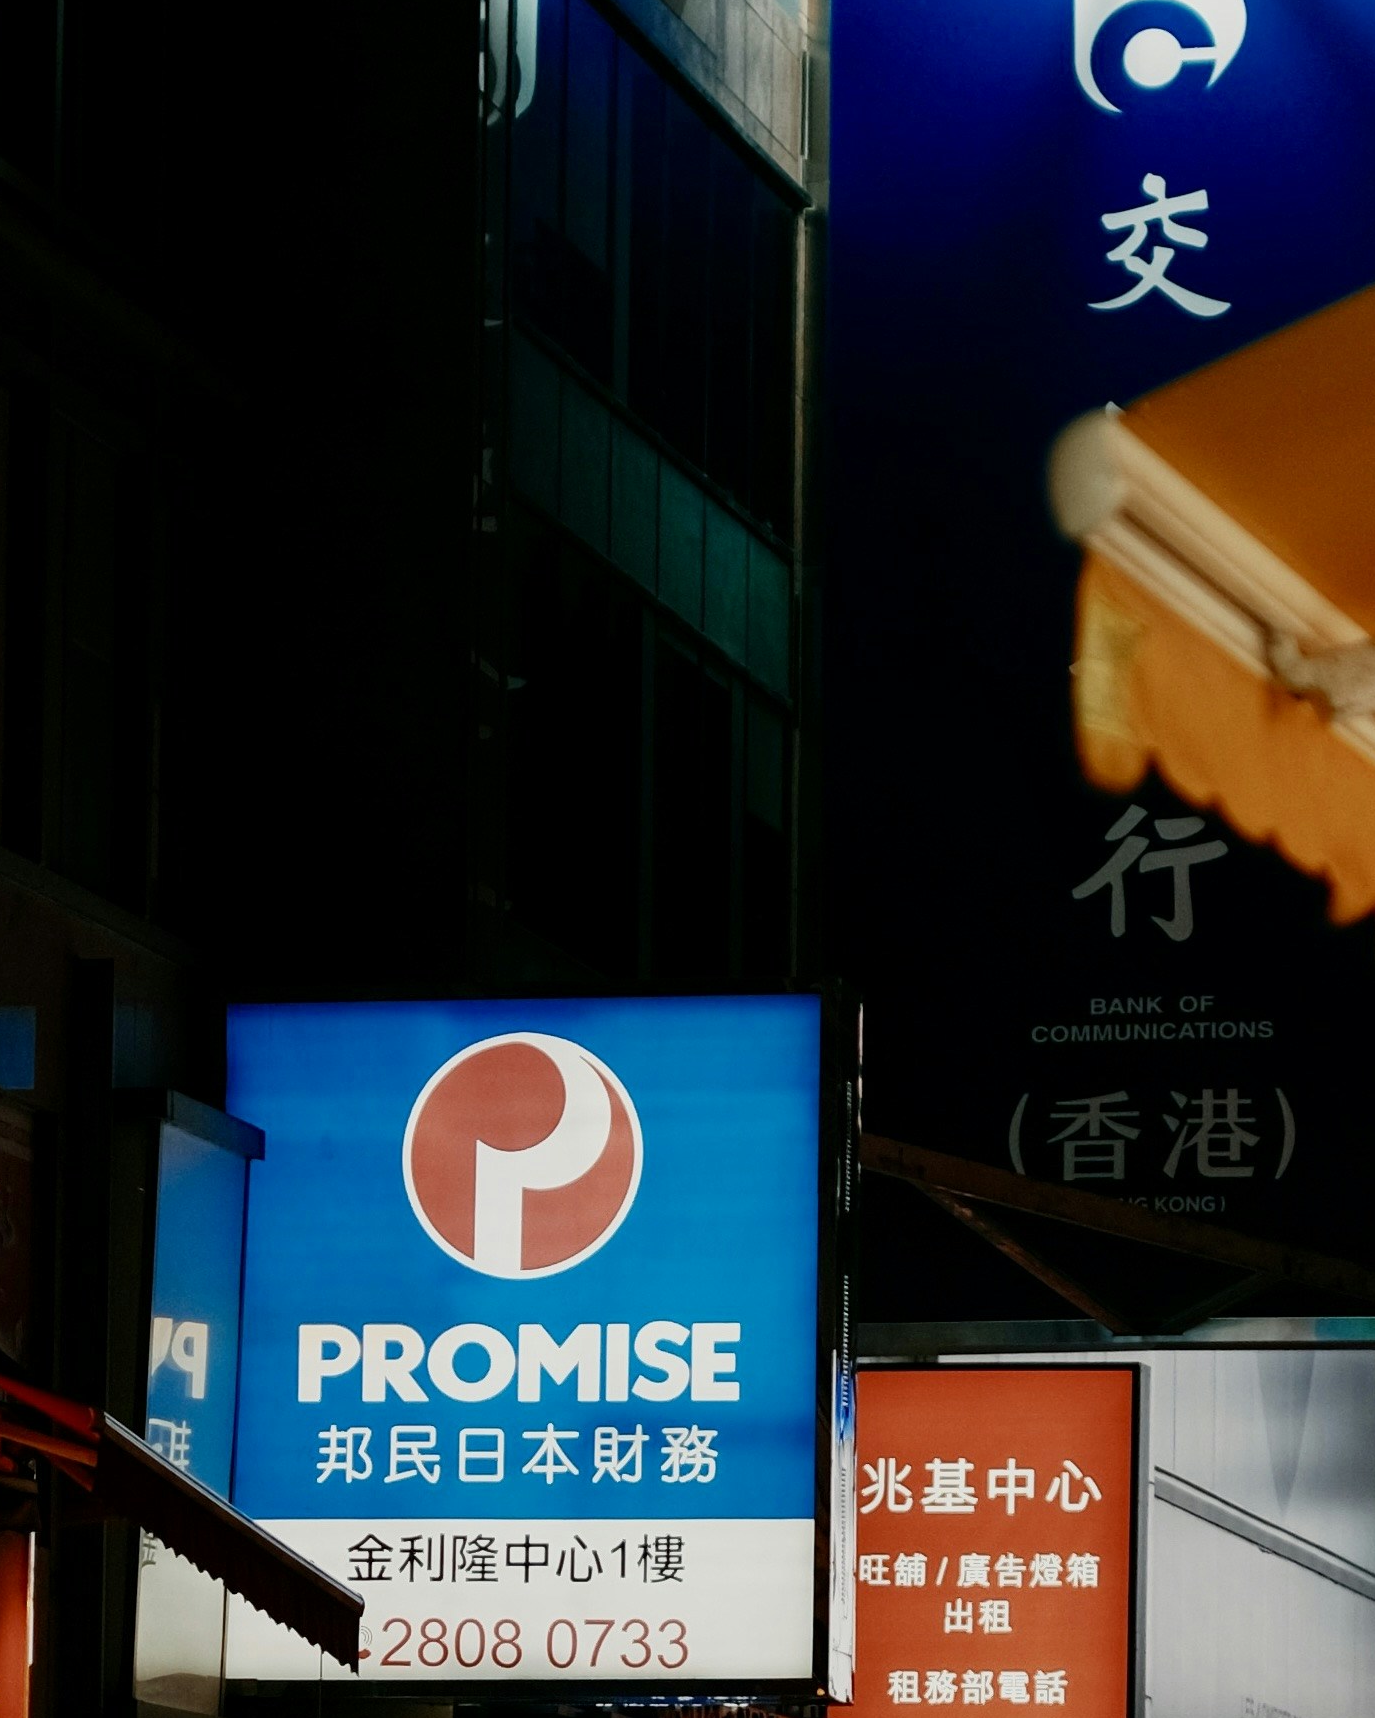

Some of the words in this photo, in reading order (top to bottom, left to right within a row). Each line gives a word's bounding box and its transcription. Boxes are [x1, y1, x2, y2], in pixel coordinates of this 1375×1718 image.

[1089, 995, 1163, 1015] BANK
[1178, 994, 1215, 1014] OF
[1030, 1019, 1275, 1044] COMMUNICATIONS
[1008, 1086, 1296, 1182] (香港)
[297, 1320, 741, 1404] PROMISE
[315, 1424, 720, 1485] 邦民日本財務
[860, 1457, 1103, 1517] 兆基中心
[347, 1532, 687, 1584] 金利隆中心1樓
[857, 1554, 928, 1588] 旺舖
[957, 1553, 1100, 1589] 廣告燈箱
[943, 1599, 1013, 1635] 出租
[381, 1618, 523, 1669] 2808
[546, 1618, 689, 1669] 0733
[887, 1670, 1069, 1706] 租務部電話
